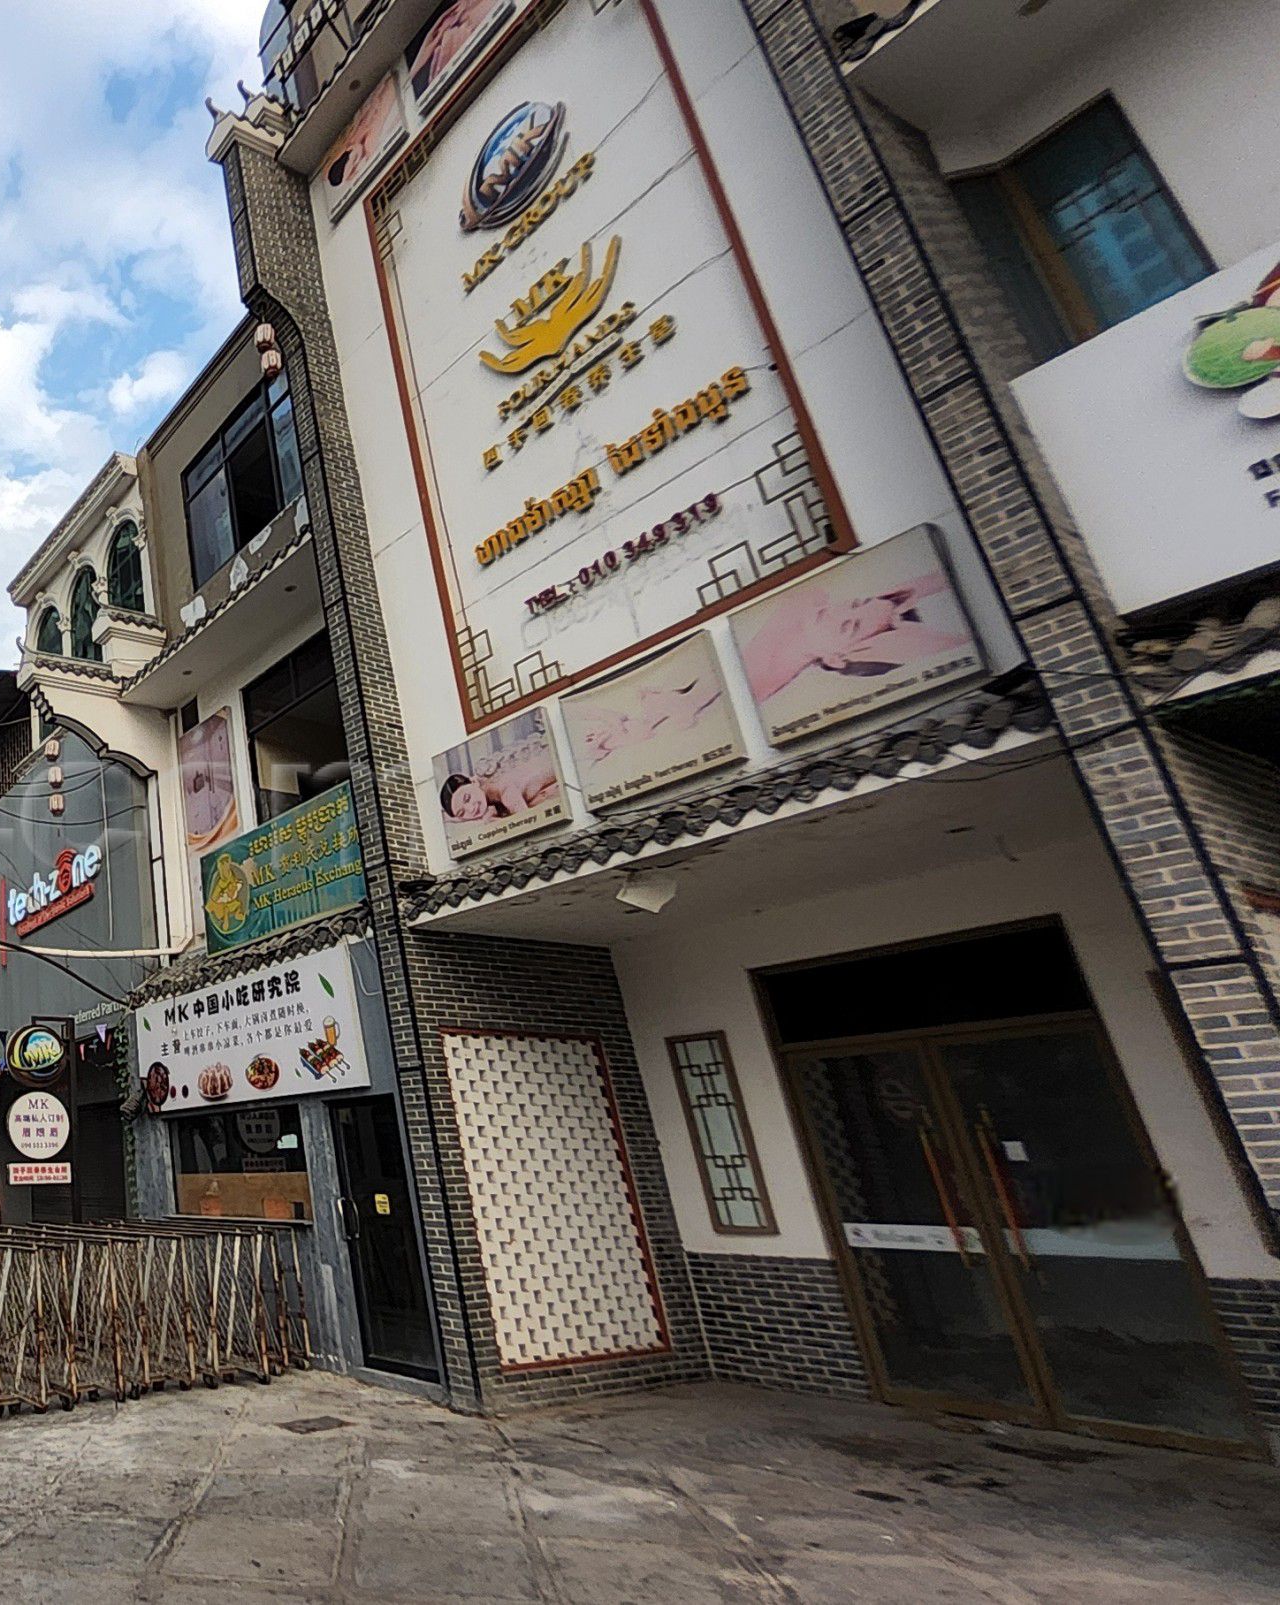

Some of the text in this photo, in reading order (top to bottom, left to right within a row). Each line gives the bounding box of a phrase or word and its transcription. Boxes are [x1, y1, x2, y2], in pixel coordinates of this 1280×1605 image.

[462, 152, 596, 294] MK GROUP
[511, 256, 573, 327] MK
[578, 549, 620, 588] 010
[477, 814, 538, 841] Cupping therapy
[7, 844, 102, 926] tech-zone
[251, 863, 276, 888] MK
[24, 1041, 60, 1067] MK
[28, 1098, 49, 1110] MK
